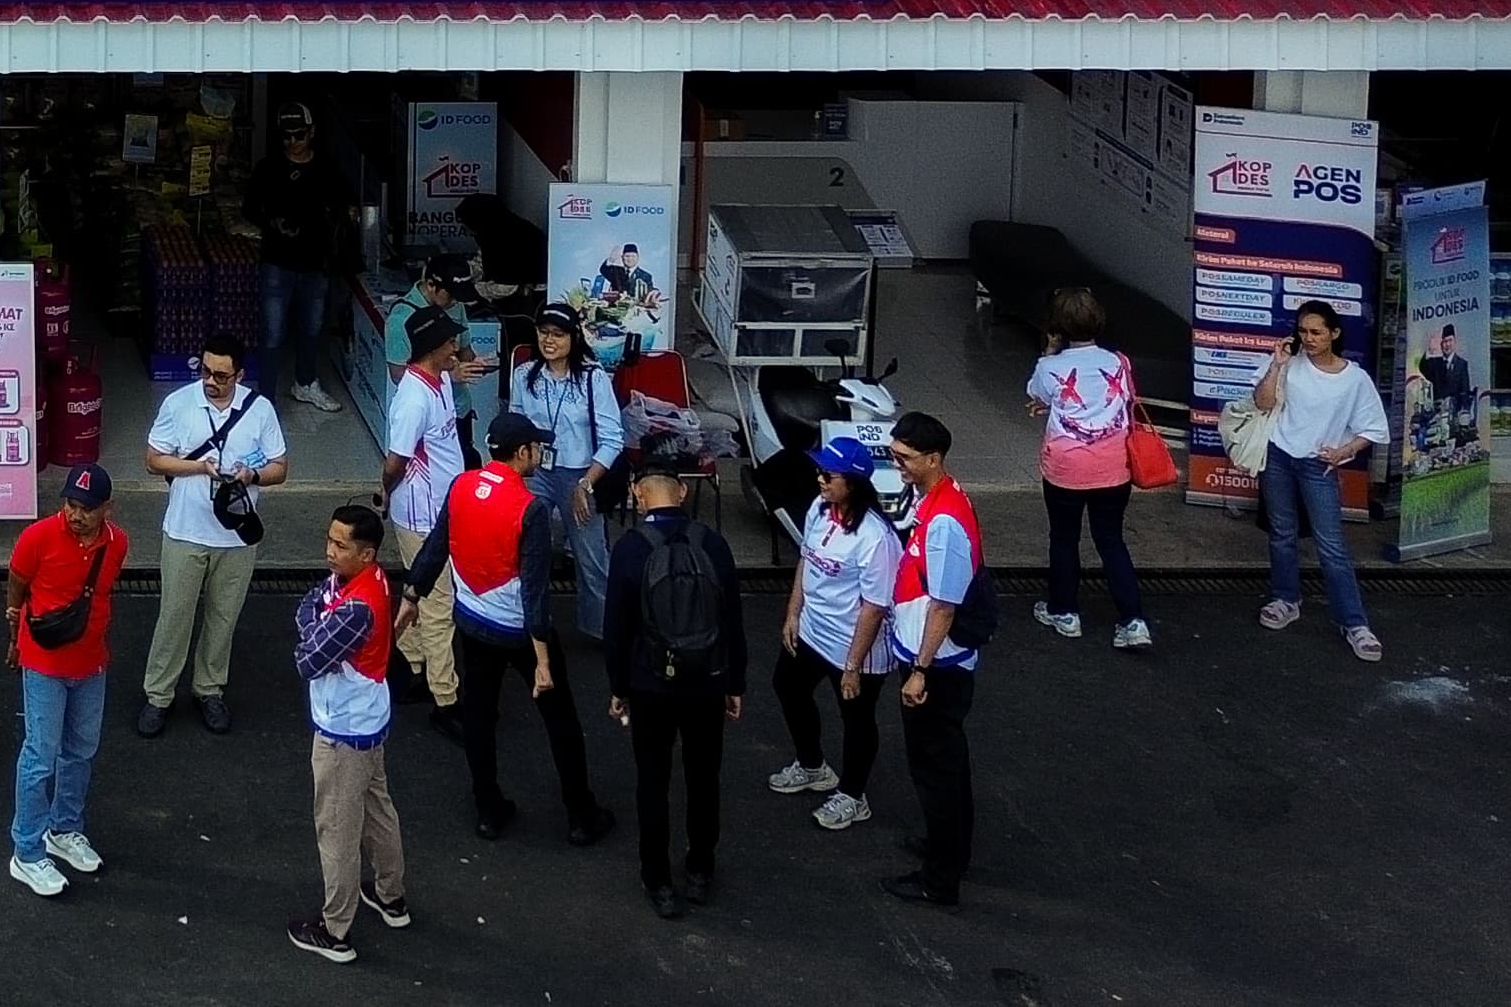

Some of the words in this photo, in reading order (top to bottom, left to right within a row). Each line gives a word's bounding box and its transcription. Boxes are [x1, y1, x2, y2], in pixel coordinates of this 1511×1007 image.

[440, 115, 454, 125] ID
[456, 115, 491, 125] FOOD
[450, 163, 481, 174] KOP
[1238, 160, 1272, 173] KOP
[828, 167, 845, 187] 2
[1238, 173, 1269, 186] DES
[1295, 164, 1362, 184] AGEN
[450, 175, 479, 187] DES
[1293, 179, 1362, 205] POS
[636, 206, 664, 215] FOOD
[1412, 296, 1480, 322] INDONESIA
[75, 470, 92, 491] A
